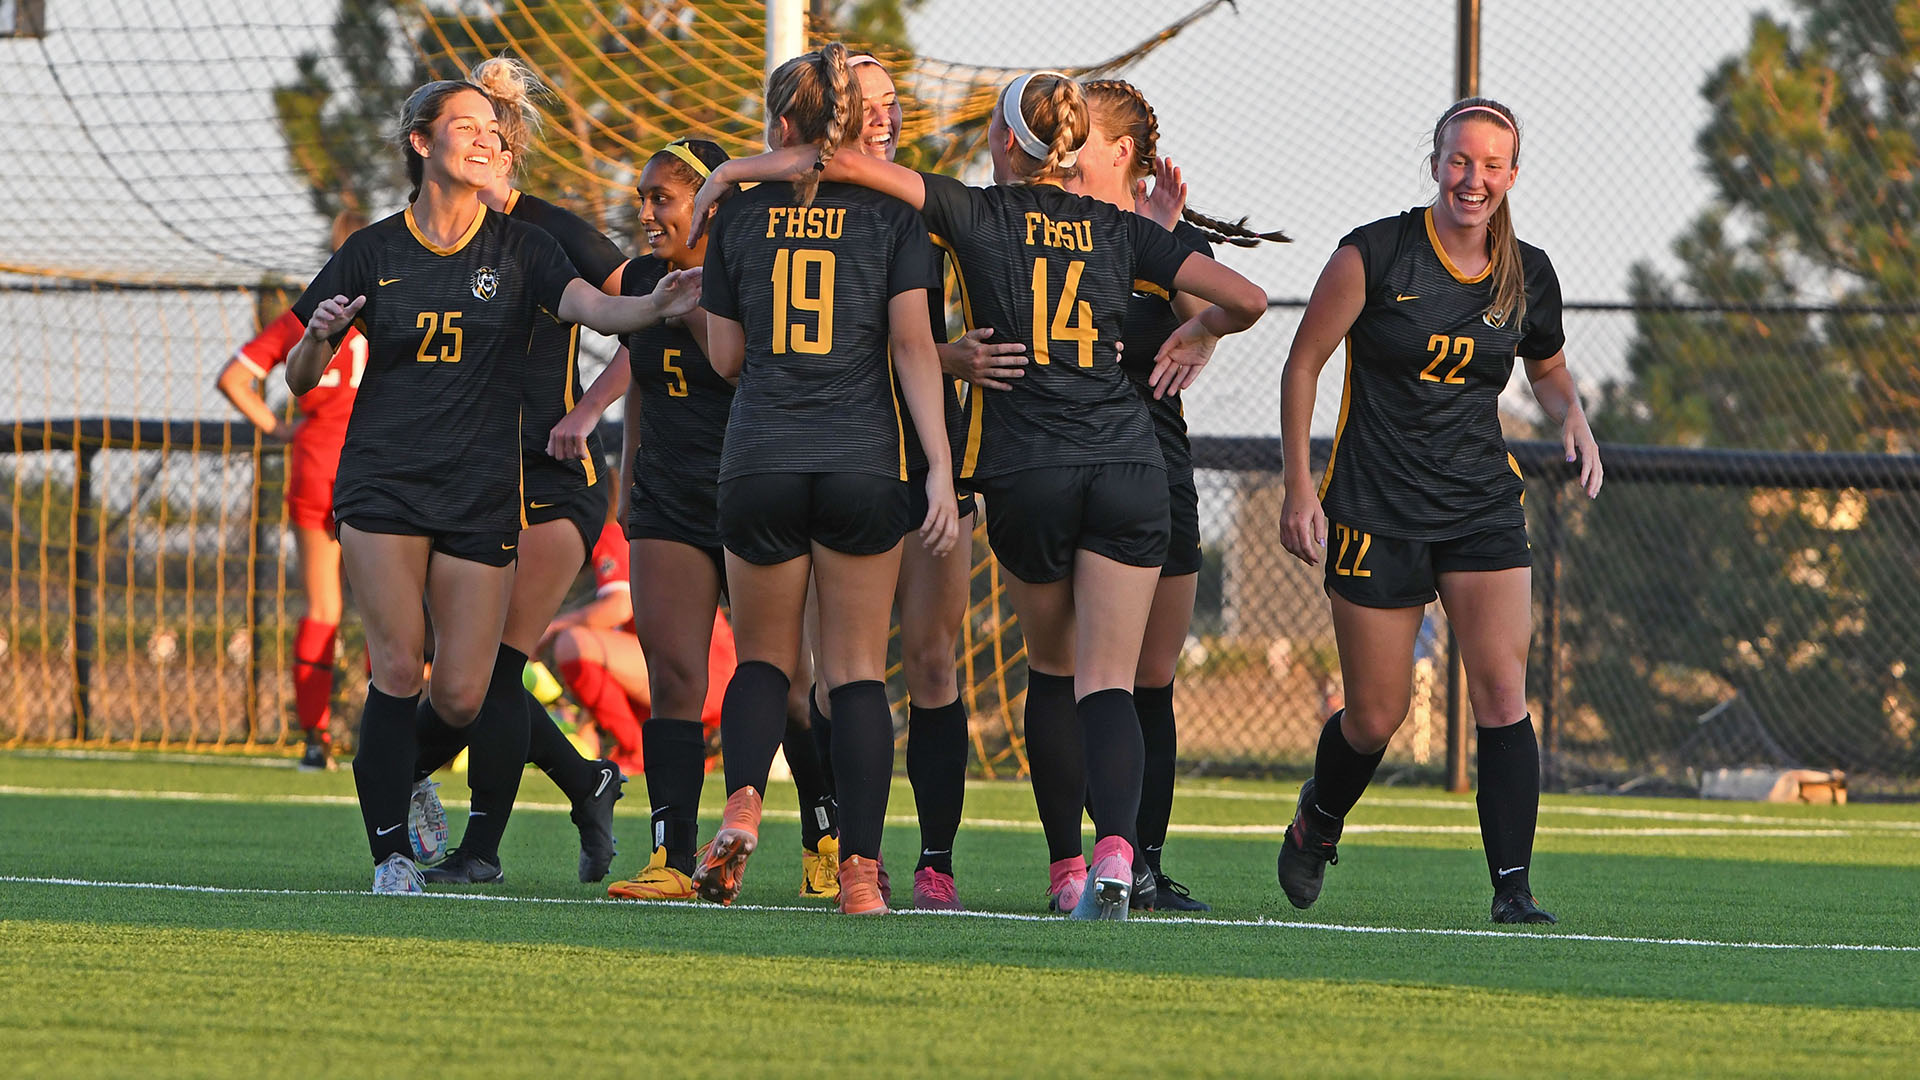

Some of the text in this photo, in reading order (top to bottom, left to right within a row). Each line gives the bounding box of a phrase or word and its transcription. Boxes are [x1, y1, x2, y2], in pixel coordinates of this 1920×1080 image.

[766, 207, 847, 240] FHSU
[1025, 211, 1094, 252] FHSU
[771, 248, 836, 355] 19
[1031, 257, 1099, 368] 14
[416, 311, 463, 363] 25
[1420, 334, 1475, 385] 22
[663, 348, 689, 397] 5
[1335, 523, 1372, 577] 22
